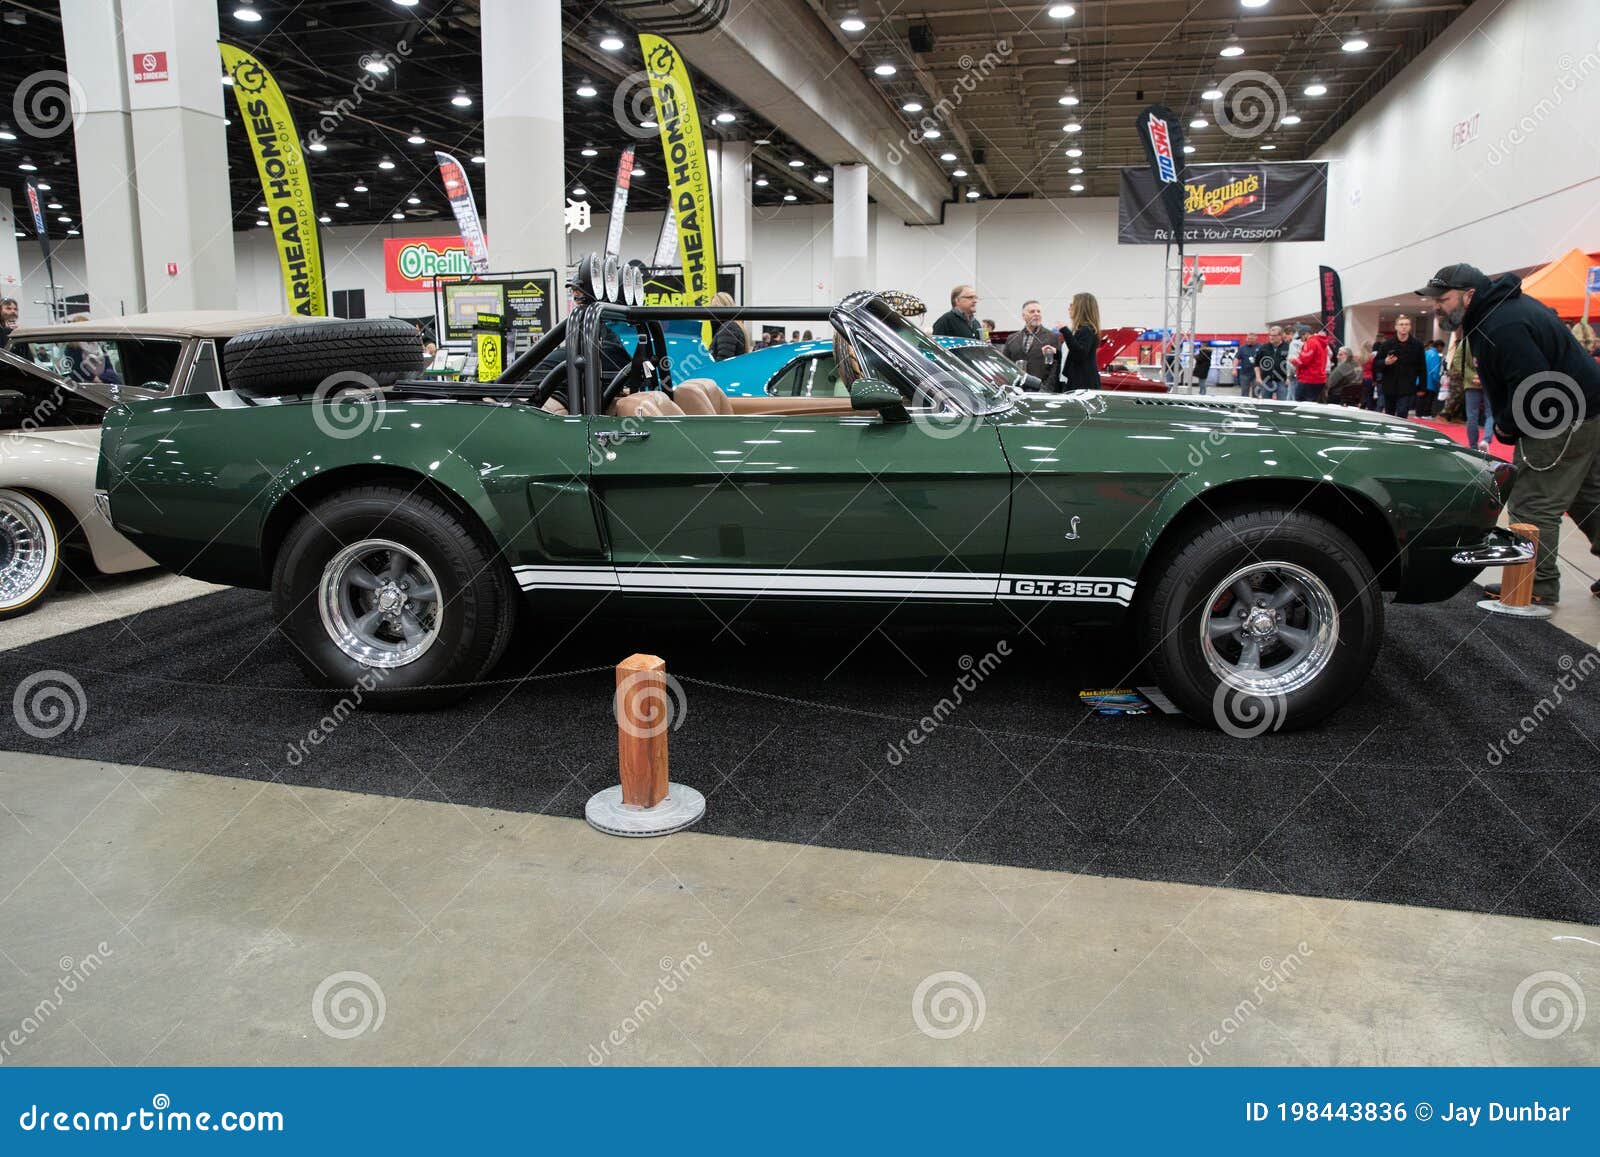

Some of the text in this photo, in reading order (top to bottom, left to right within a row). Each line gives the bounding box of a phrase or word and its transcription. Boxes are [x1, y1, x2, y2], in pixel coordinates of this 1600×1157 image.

[657, 83, 691, 187] HOMES
[1149, 113, 1177, 183] AMSOIL
[247, 99, 312, 317] ARHEAD HOMES
[1184, 174, 1260, 215] Meguiar's
[1203, 228, 1230, 240] Your
[402, 244, 473, 278] O'Reilly
[1183, 265, 1241, 274] COCESSIONS
